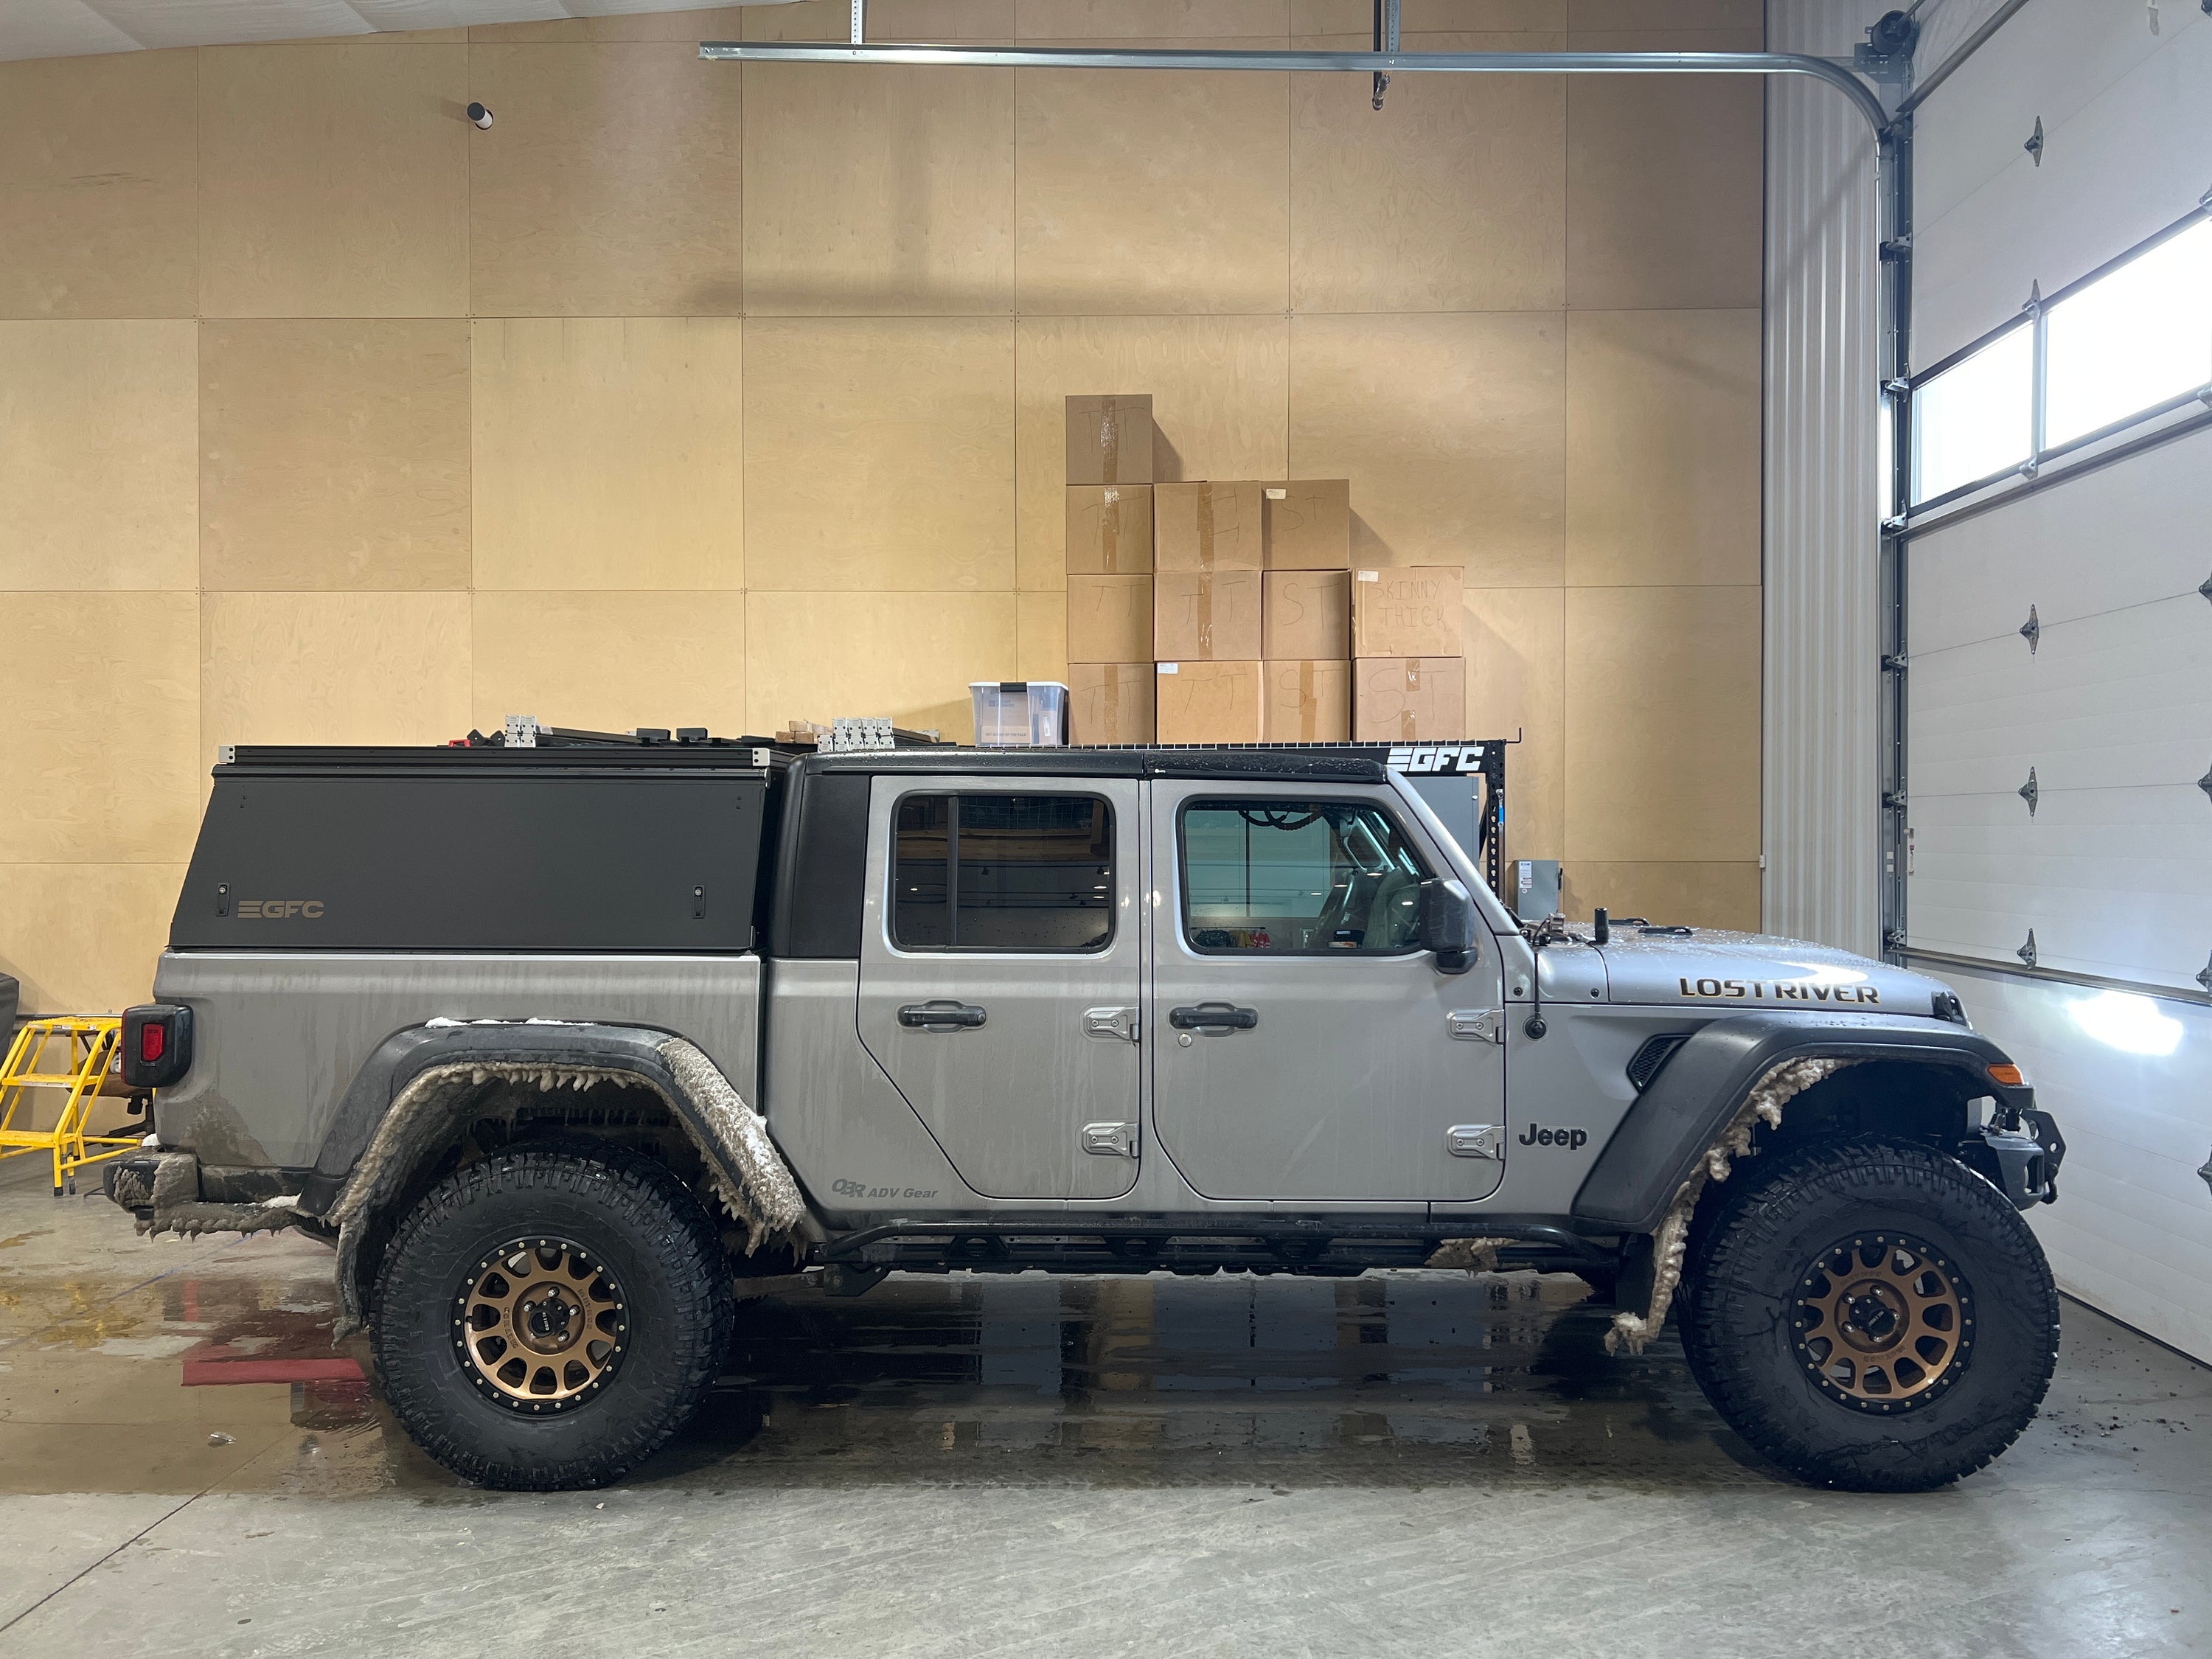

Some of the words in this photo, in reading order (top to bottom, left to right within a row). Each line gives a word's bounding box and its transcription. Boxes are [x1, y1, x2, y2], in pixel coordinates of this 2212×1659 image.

[1371, 580, 1441, 601] SKINNY
[1377, 605, 1447, 632] THICK
[1678, 977, 1770, 999] LOST
[1773, 981, 1880, 1004] RIVER
[1519, 1123, 1587, 1151] Jeep
[831, 1178, 866, 1198] OBR
[867, 1187, 900, 1198] ADV
[903, 1187, 939, 1199] Gear
